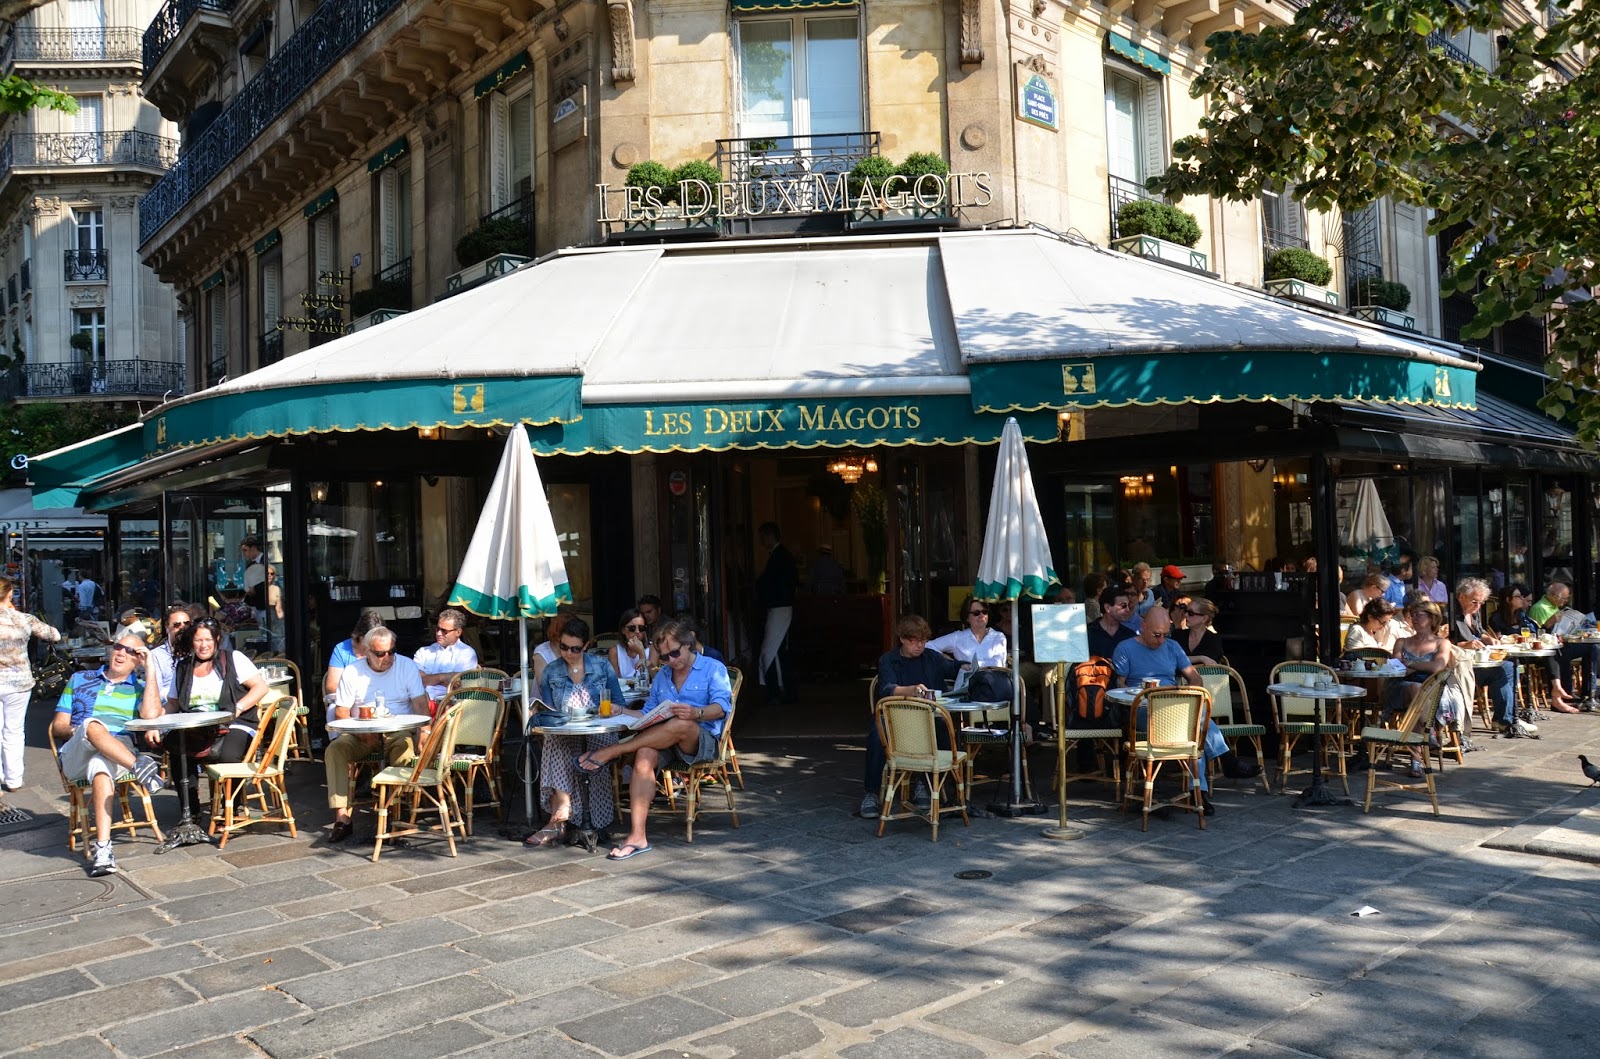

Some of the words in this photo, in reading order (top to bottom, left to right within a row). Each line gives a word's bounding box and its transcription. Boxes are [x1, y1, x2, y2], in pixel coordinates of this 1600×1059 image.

[595, 182, 664, 223] LES
[677, 179, 799, 219] DEUX
[812, 170, 994, 213] MAGOTS
[643, 410, 692, 436] LES
[703, 408, 785, 435] DEUX
[798, 405, 921, 432] MAGOTS
